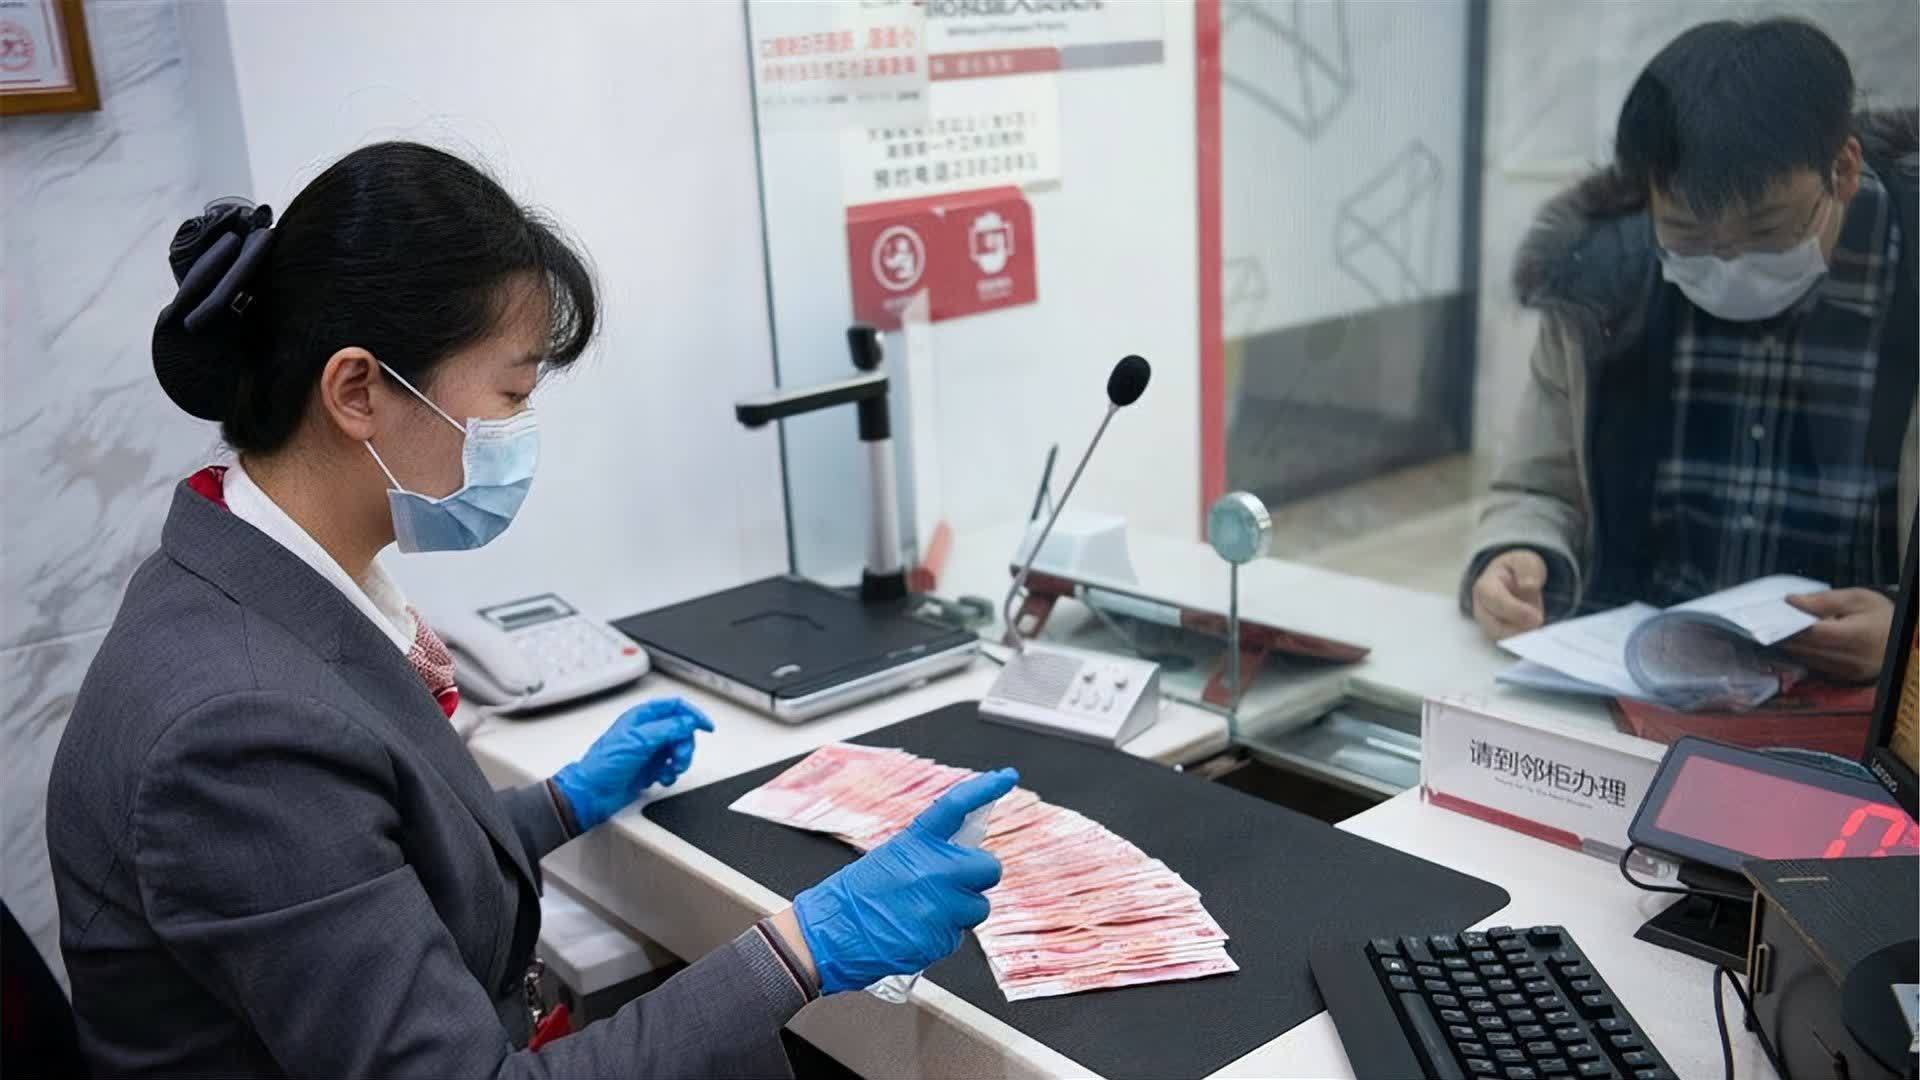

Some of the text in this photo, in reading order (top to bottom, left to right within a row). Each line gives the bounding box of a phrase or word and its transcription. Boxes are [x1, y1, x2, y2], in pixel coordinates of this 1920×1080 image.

[1469, 739, 1627, 808] 请到邻柜办理
